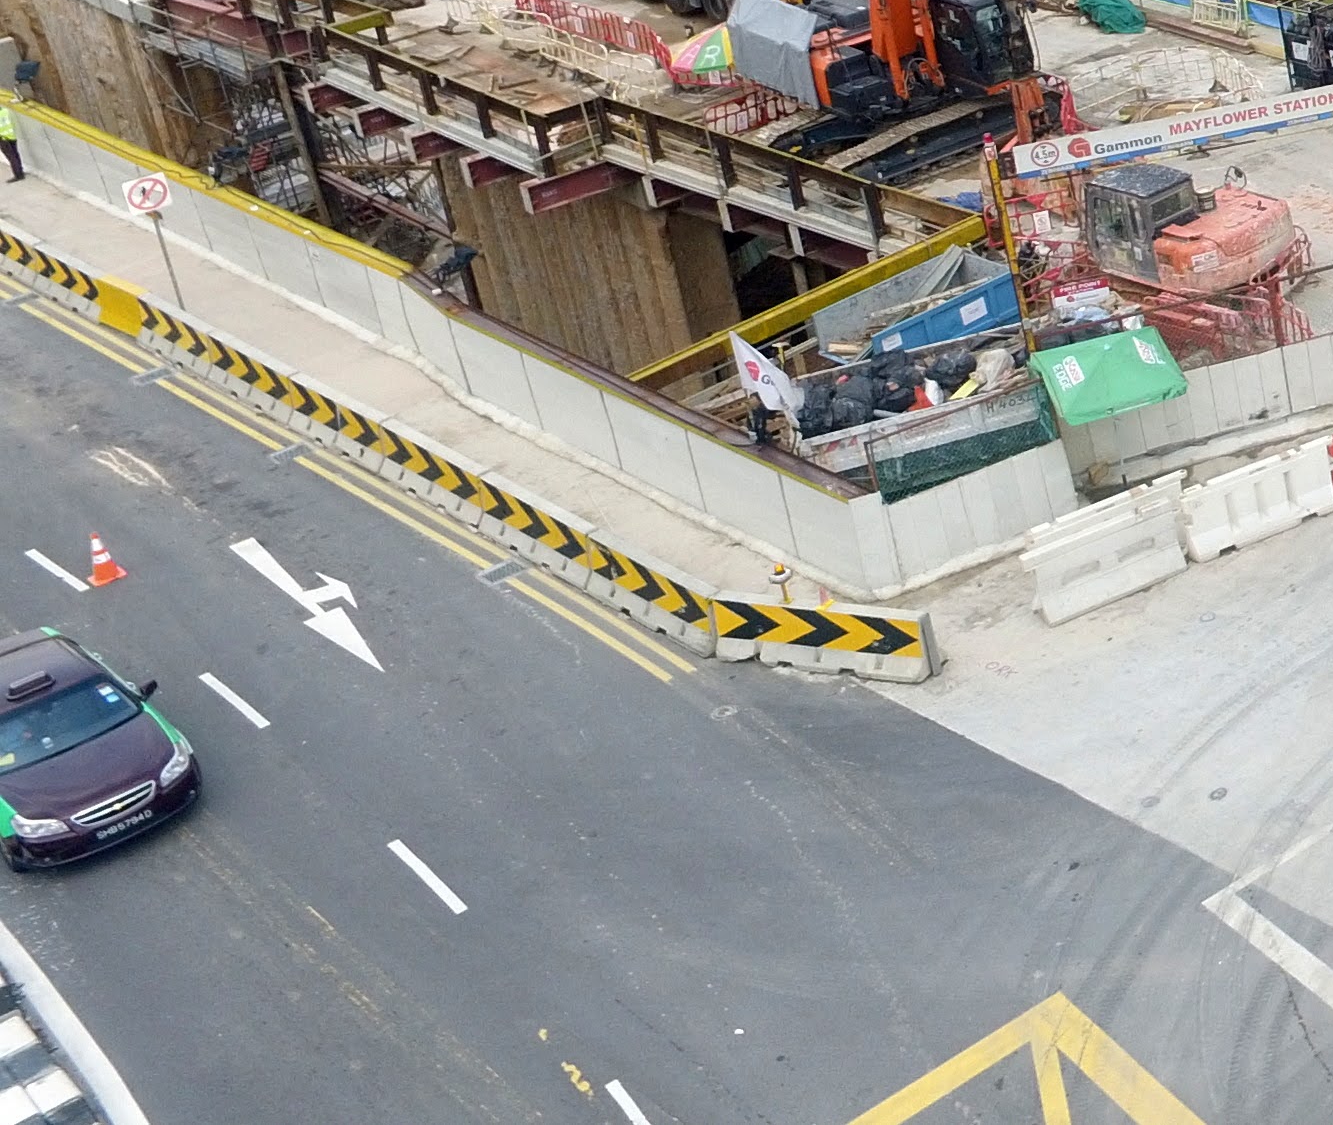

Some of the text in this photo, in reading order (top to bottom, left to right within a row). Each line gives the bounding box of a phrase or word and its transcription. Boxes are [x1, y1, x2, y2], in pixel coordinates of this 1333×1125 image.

[1169, 106, 1269, 136] MAYFLOWER
[1094, 133, 1163, 155] Gammon
[1052, 363, 1073, 392] EDGE
